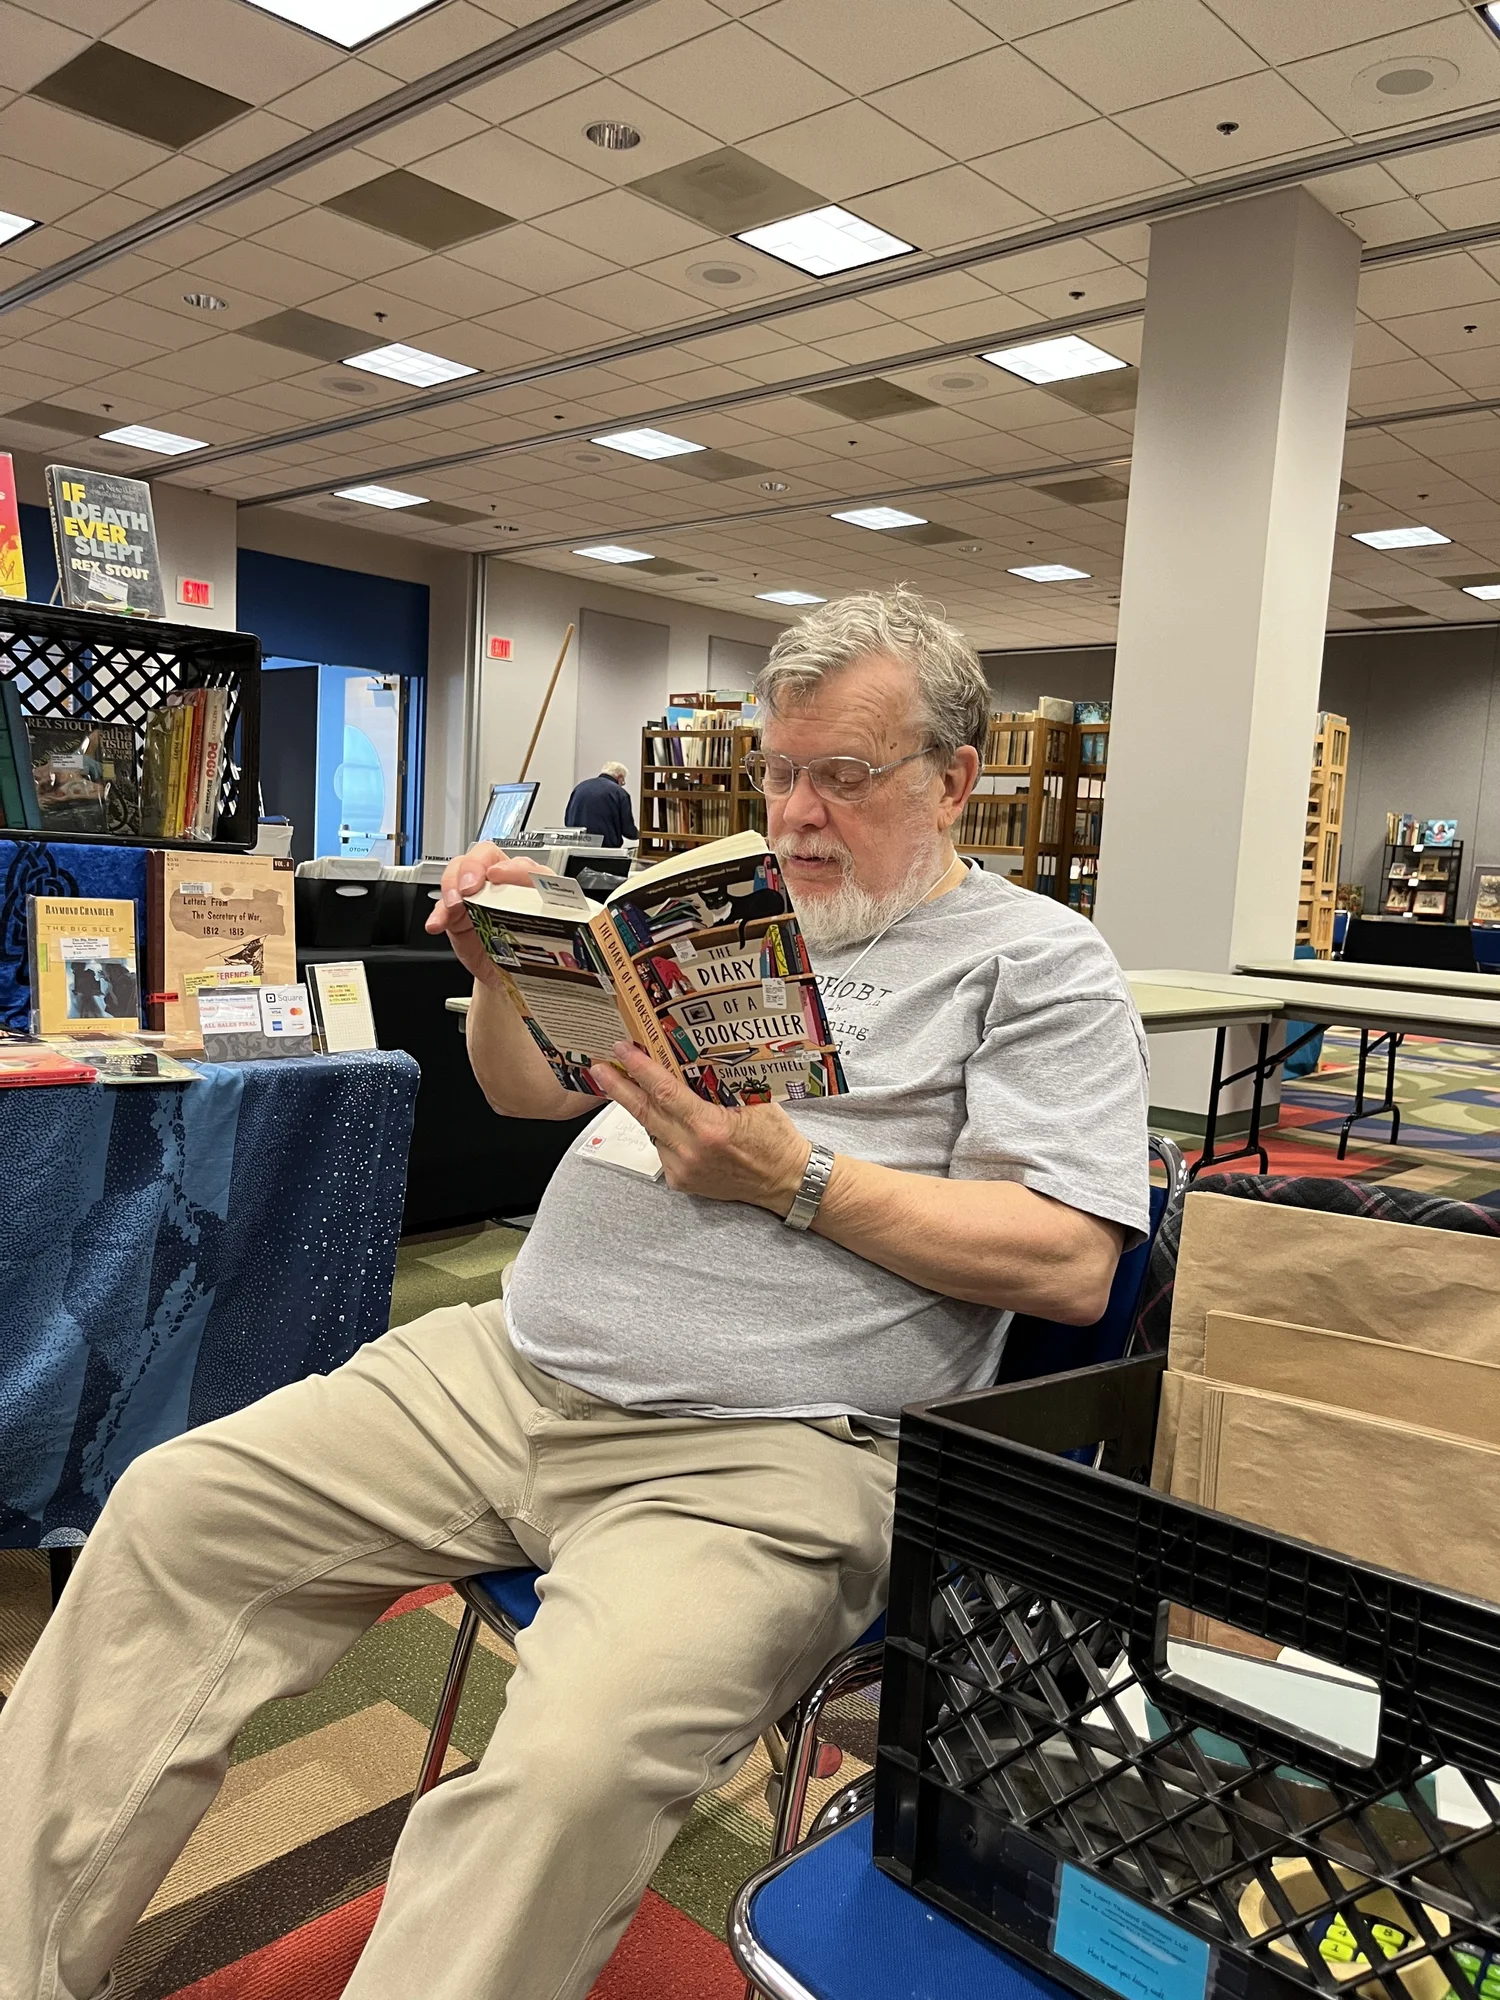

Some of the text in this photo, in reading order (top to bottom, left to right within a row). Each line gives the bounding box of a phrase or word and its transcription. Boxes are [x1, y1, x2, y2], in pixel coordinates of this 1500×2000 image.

[62, 481, 86, 503] IF
[70, 501, 148, 532] DEATH
[63, 516, 128, 546] EVER
[74, 535, 144, 565] SLEPT
[70, 558, 149, 580] REX STOUT
[28, 718, 94, 732] REX STOUT
[100, 727, 132, 741] atha
[100, 738, 133, 749] ristie
[206, 742, 218, 778] POGO
[183, 896, 228, 907] Letters From
[46, 905, 114, 917] RAYMOND CHANDLER
[192, 910, 262, 922] The Secretary of War,
[203, 926, 219, 935] 1812
[229, 927, 244, 936] 1813
[708, 946, 733, 960] THE
[217, 971, 249, 980] FERENCE
[696, 958, 756, 986] DIARY
[278, 994, 303, 1003] Square
[599, 922, 672, 1071] THE DIARY OF A BOOKSELLER SHAUN
[723, 996, 758, 1014] OF A
[692, 1014, 805, 1047] BOOKSELLER
[828, 1020, 869, 1041] ning
[718, 1060, 807, 1079] SHAUN BYTHELL
[1331, 1944, 1339, 1952] 1
